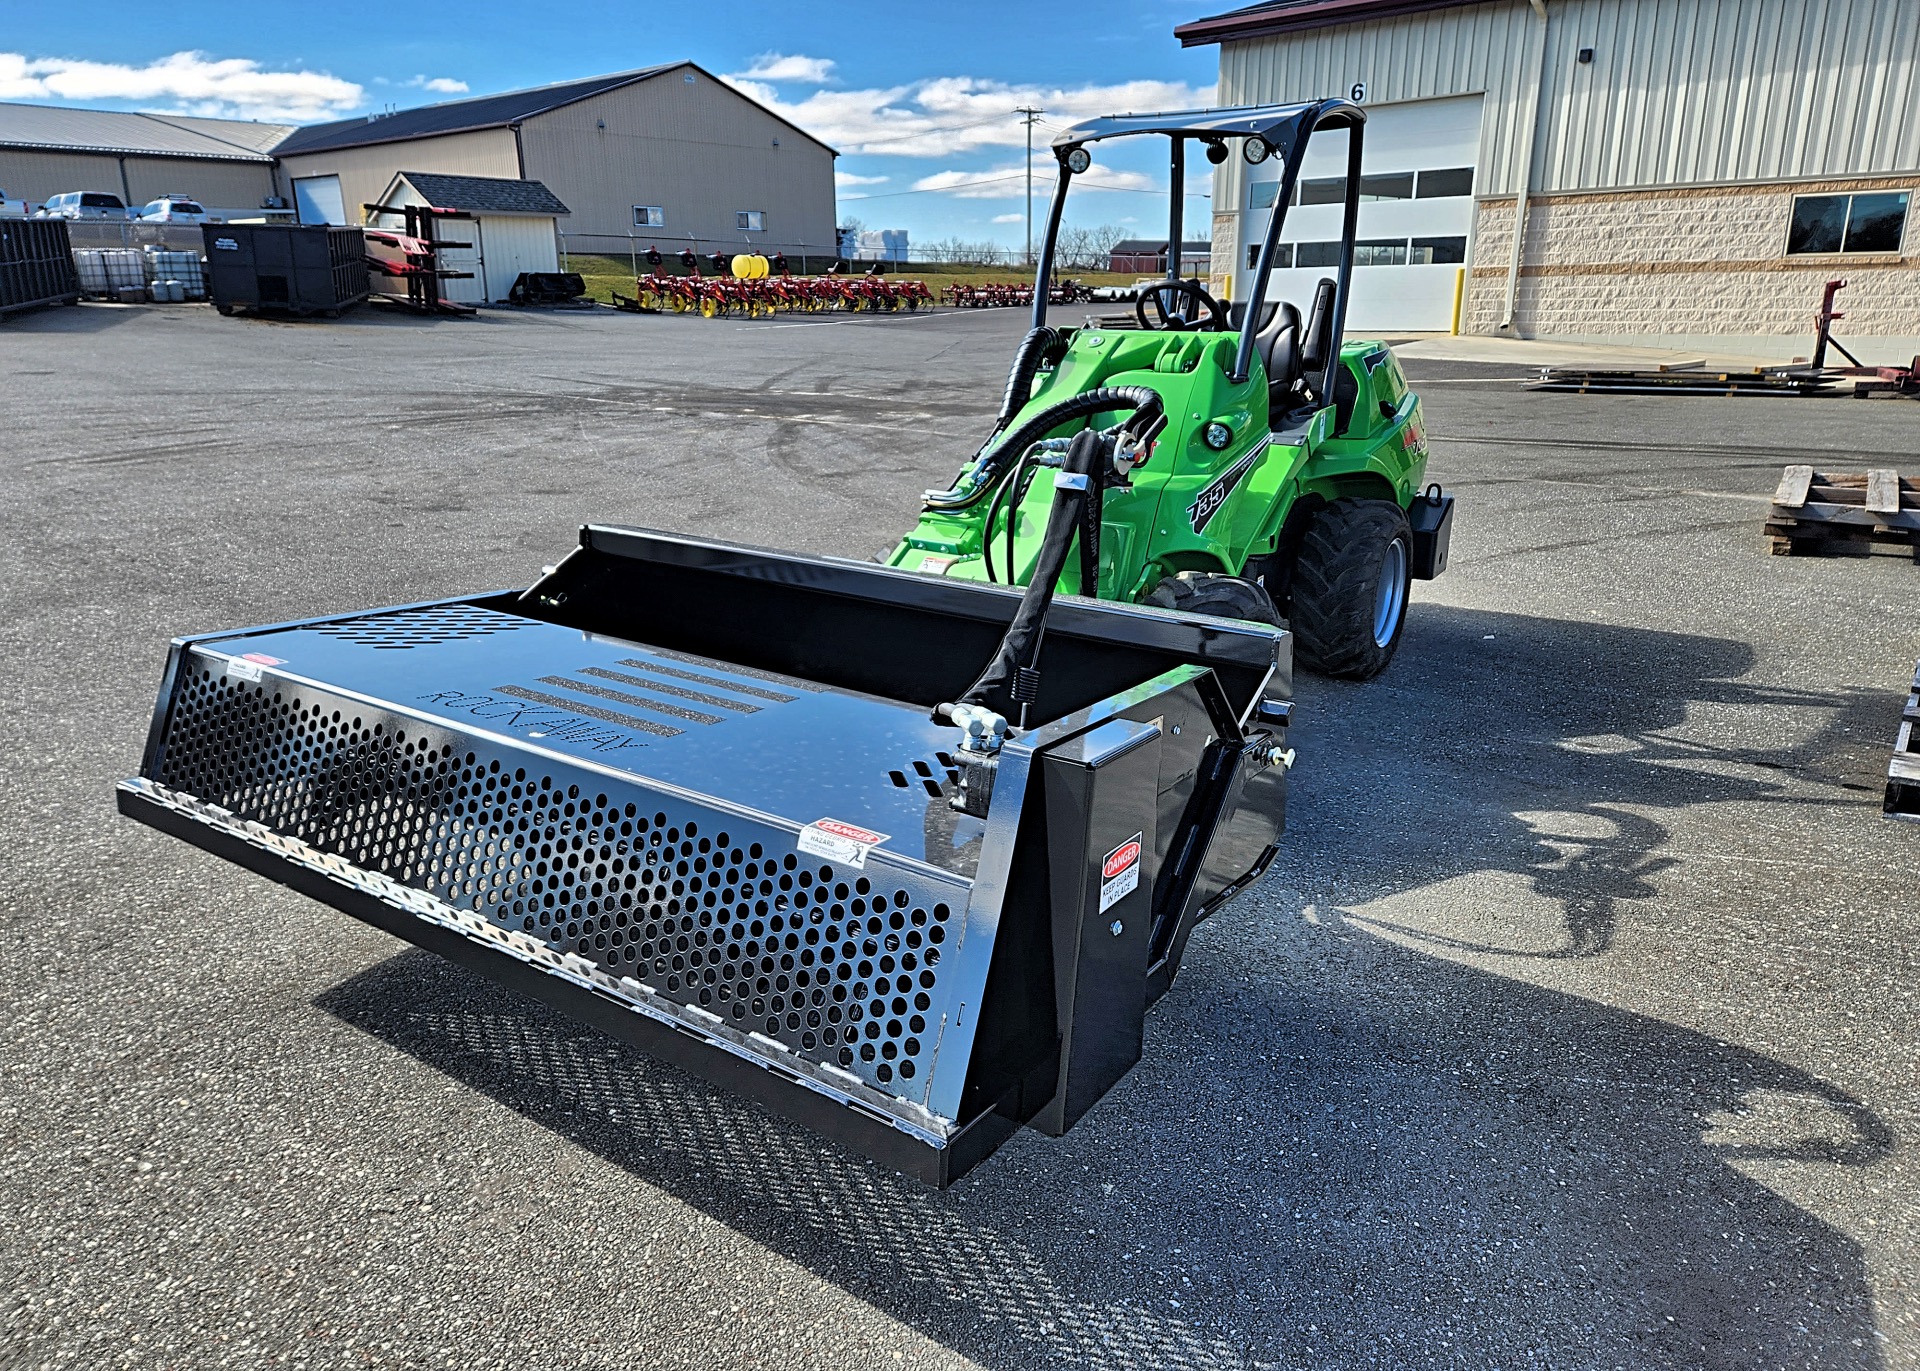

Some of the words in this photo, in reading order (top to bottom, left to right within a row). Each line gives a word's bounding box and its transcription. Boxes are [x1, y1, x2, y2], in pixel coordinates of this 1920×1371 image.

[1351, 83, 1364, 101] 6
[1186, 482, 1225, 524] 735
[810, 835, 835, 847] HAZARD
[821, 821, 875, 842] DANGER
[1107, 845, 1137, 875] DANGER
[1103, 881, 1116, 897] KEEP
[1116, 867, 1137, 887] GUARDS
[1107, 895, 1114, 904] IN
[1113, 881, 1131, 900] PLACE
